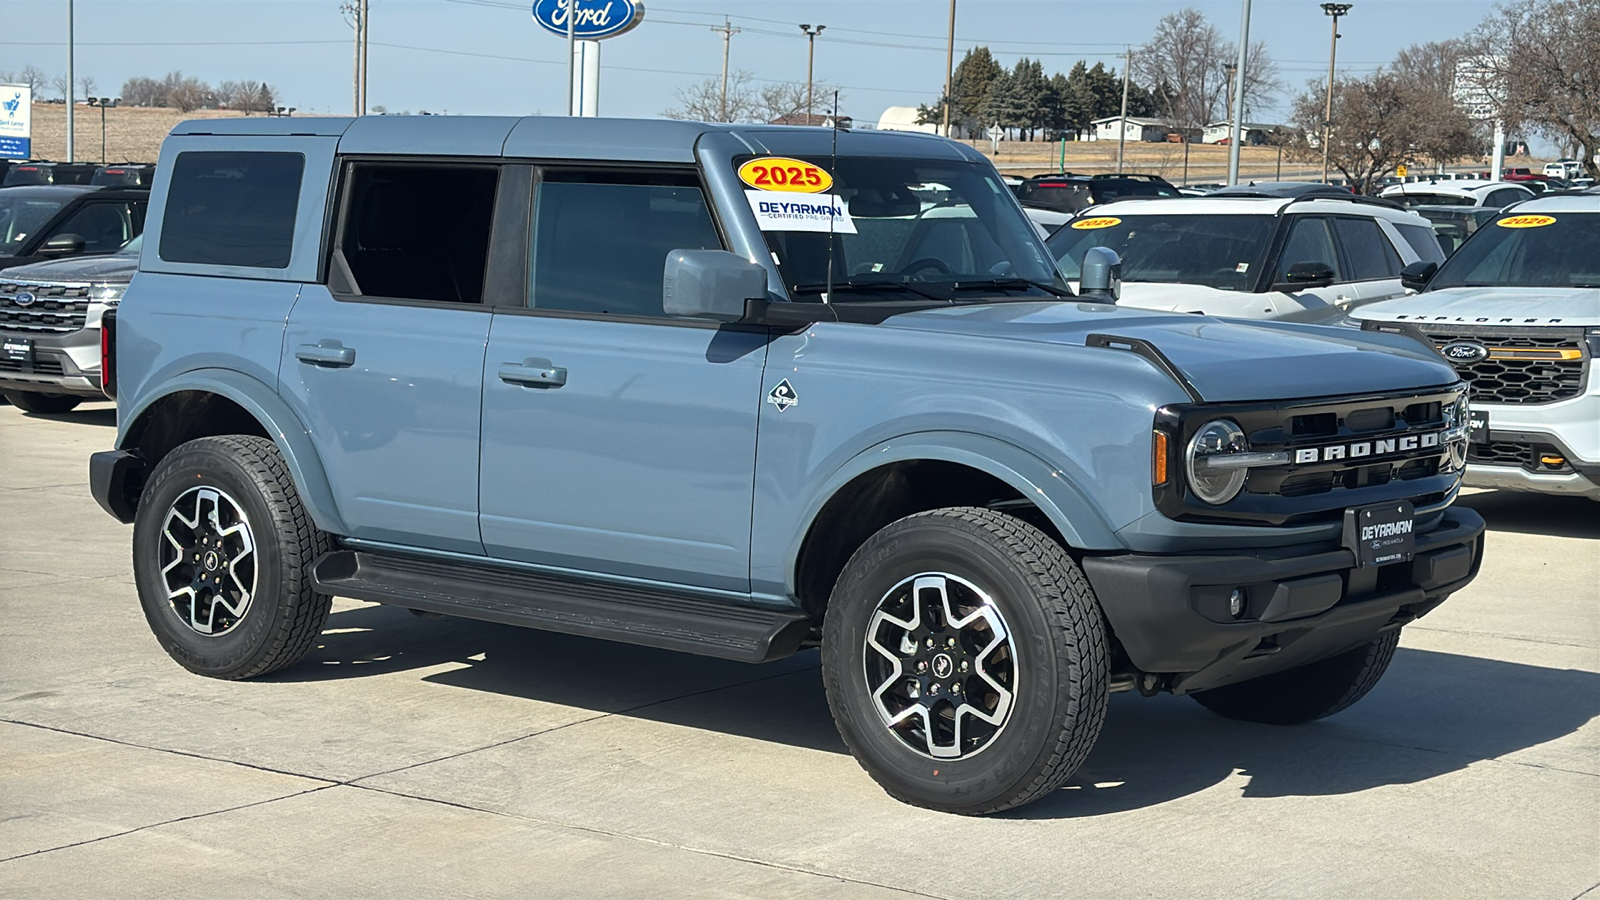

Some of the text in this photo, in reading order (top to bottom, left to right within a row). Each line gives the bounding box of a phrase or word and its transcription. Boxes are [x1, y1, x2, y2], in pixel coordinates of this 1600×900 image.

[752, 166, 822, 187] 2025
[759, 202, 843, 217] DEYARMAN
[1396, 315, 1562, 323] EXPLORER
[1450, 346, 1475, 358] Ford
[1296, 432, 1438, 464] BRONCO
[1362, 520, 1413, 540] DEYARMAN
